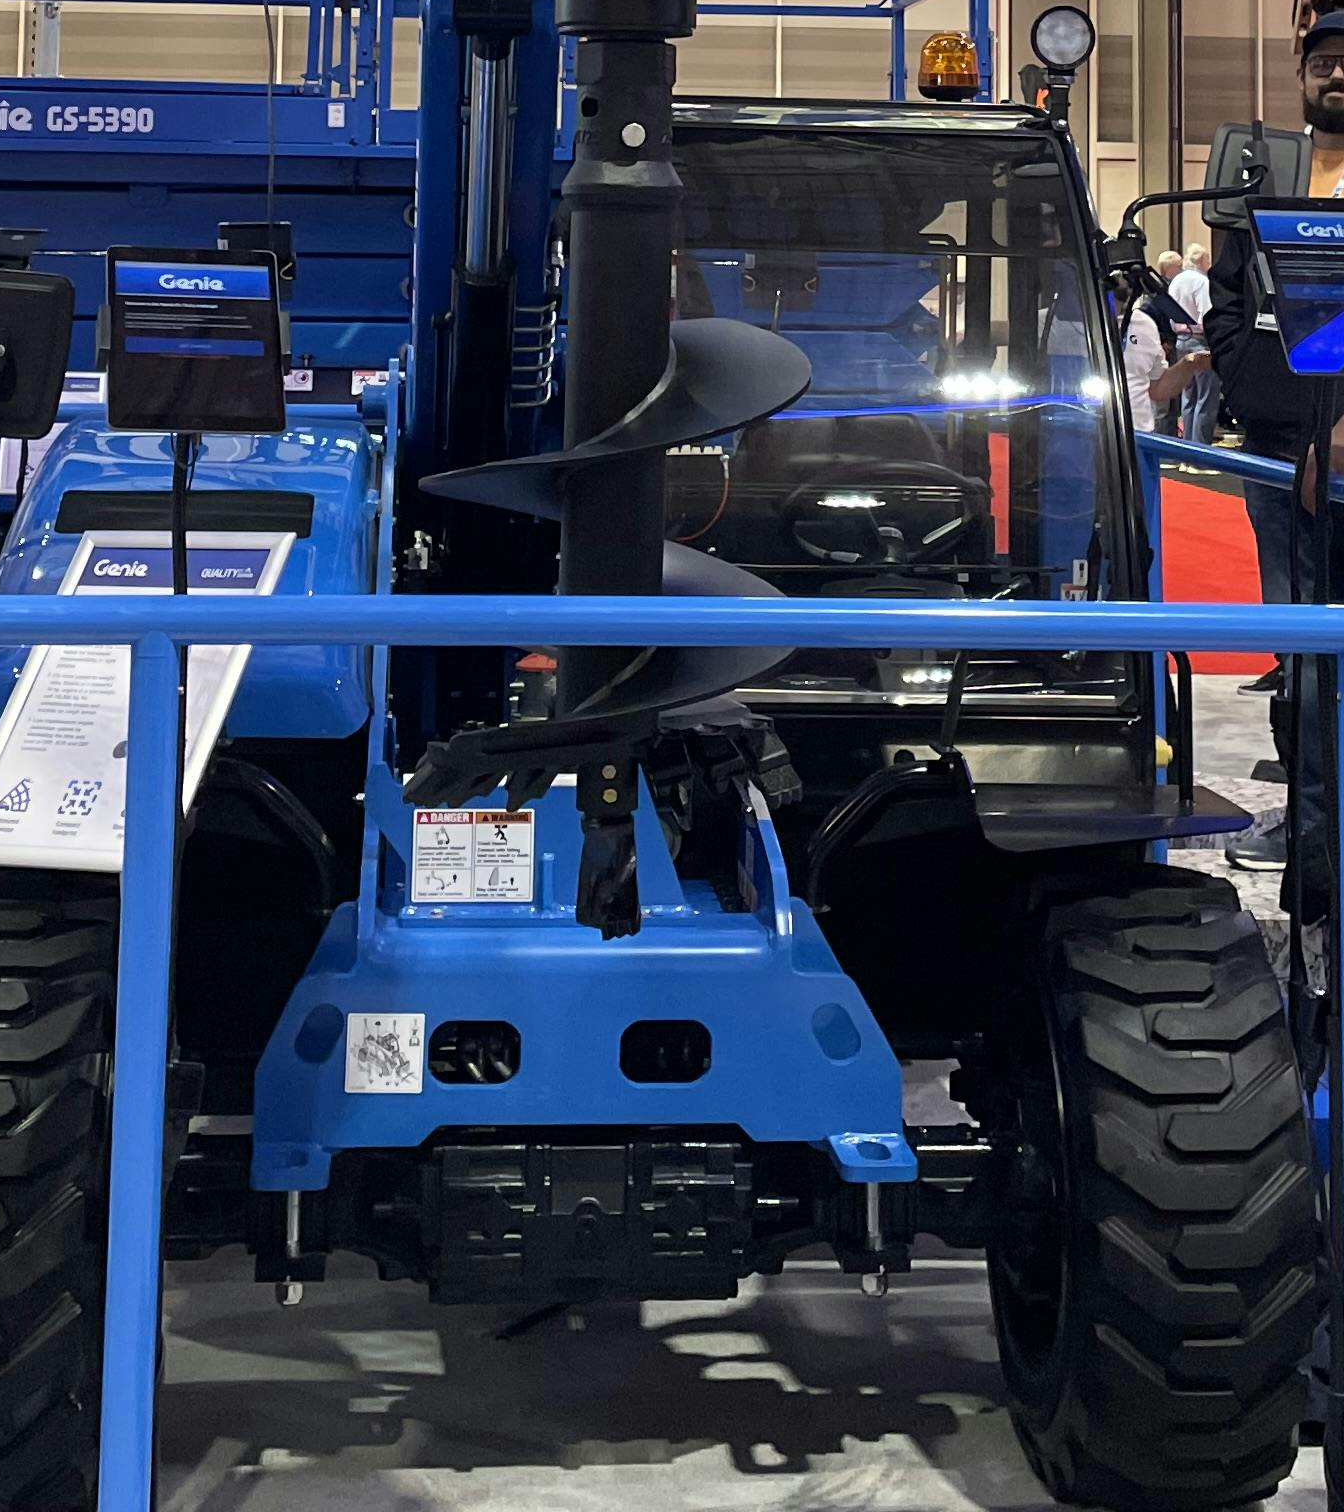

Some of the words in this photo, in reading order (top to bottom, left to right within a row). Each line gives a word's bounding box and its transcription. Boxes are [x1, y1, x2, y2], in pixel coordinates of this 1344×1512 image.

[46, 105, 155, 135] GS-5390
[158, 273, 225, 291] Genie
[93, 558, 149, 577] Genie
[200, 567, 238, 579] QUALITY
[430, 812, 471, 824] DANGER
